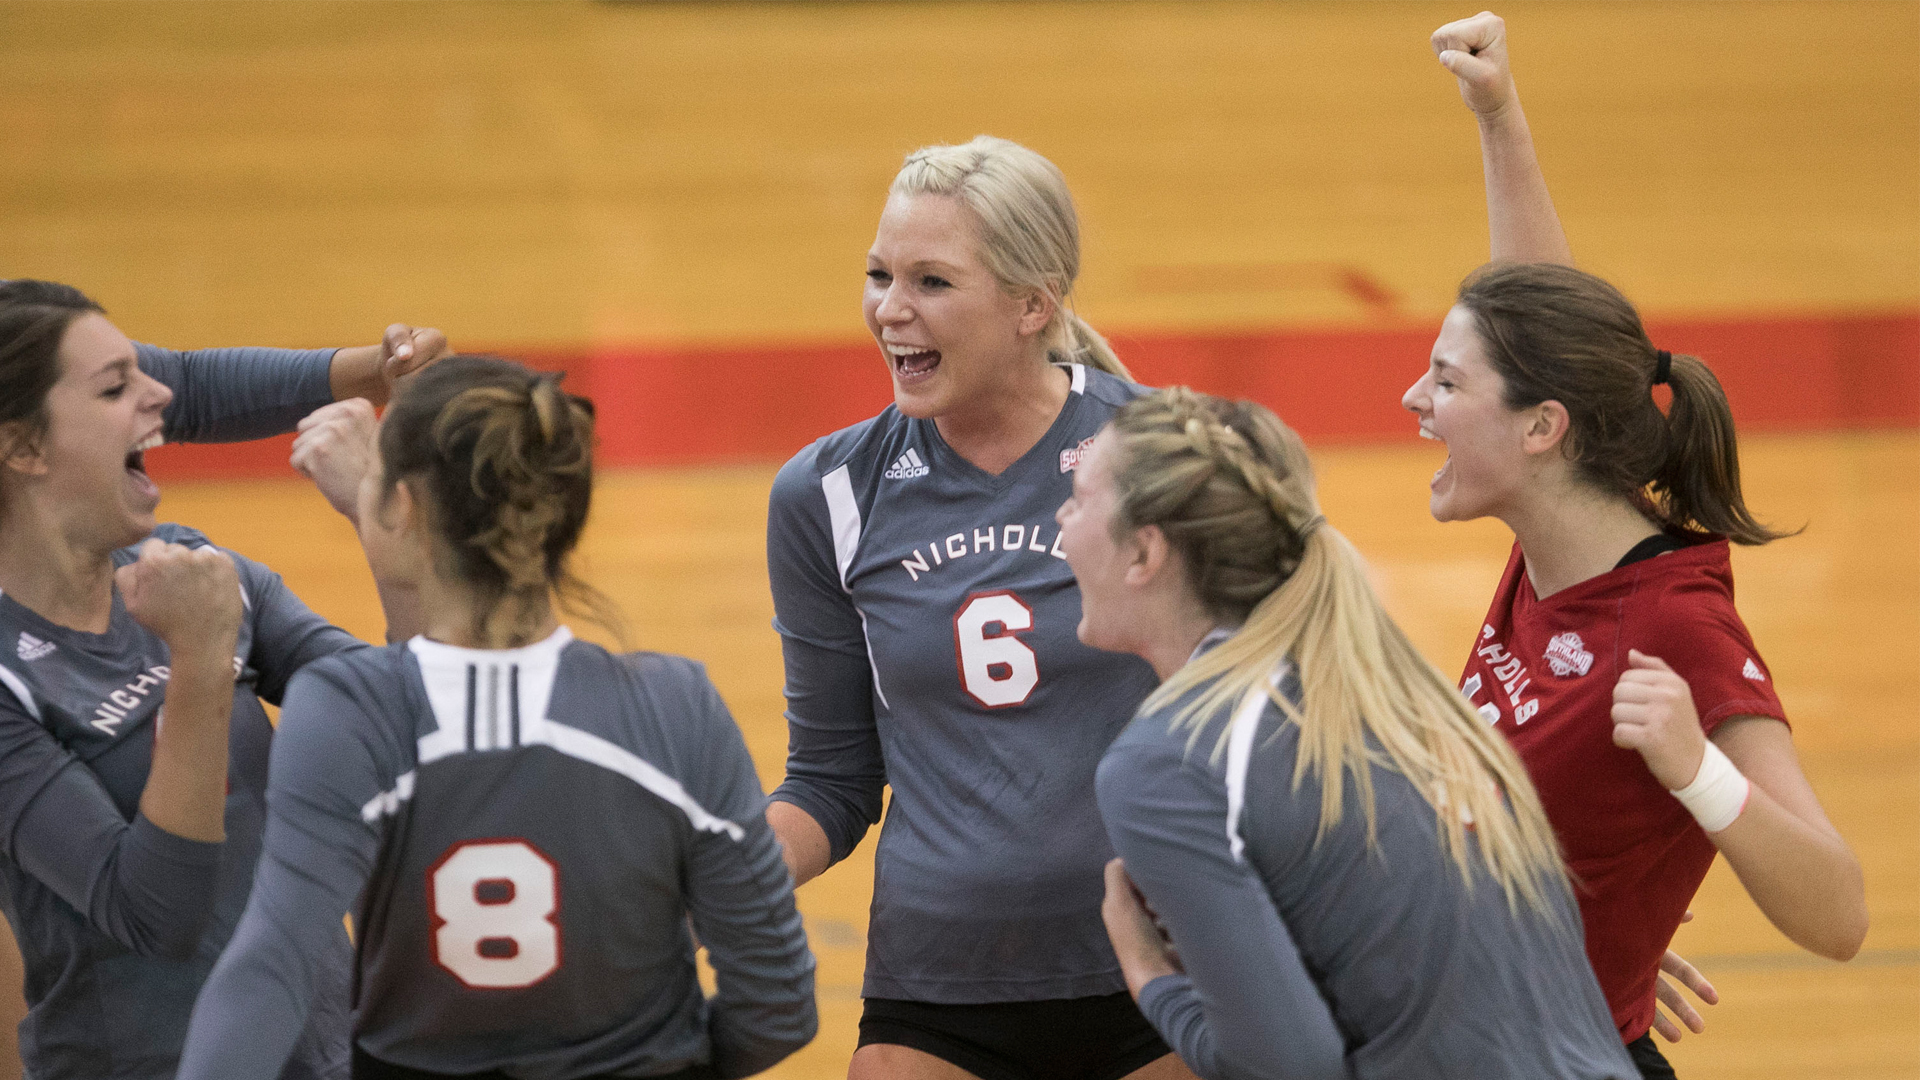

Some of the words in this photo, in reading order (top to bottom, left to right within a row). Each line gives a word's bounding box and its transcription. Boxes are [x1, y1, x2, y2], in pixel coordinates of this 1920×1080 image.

[885, 465, 930, 480] adidas
[901, 524, 1068, 582] NICHOLL
[953, 589, 1040, 710] 6
[426, 837, 563, 990] 8
